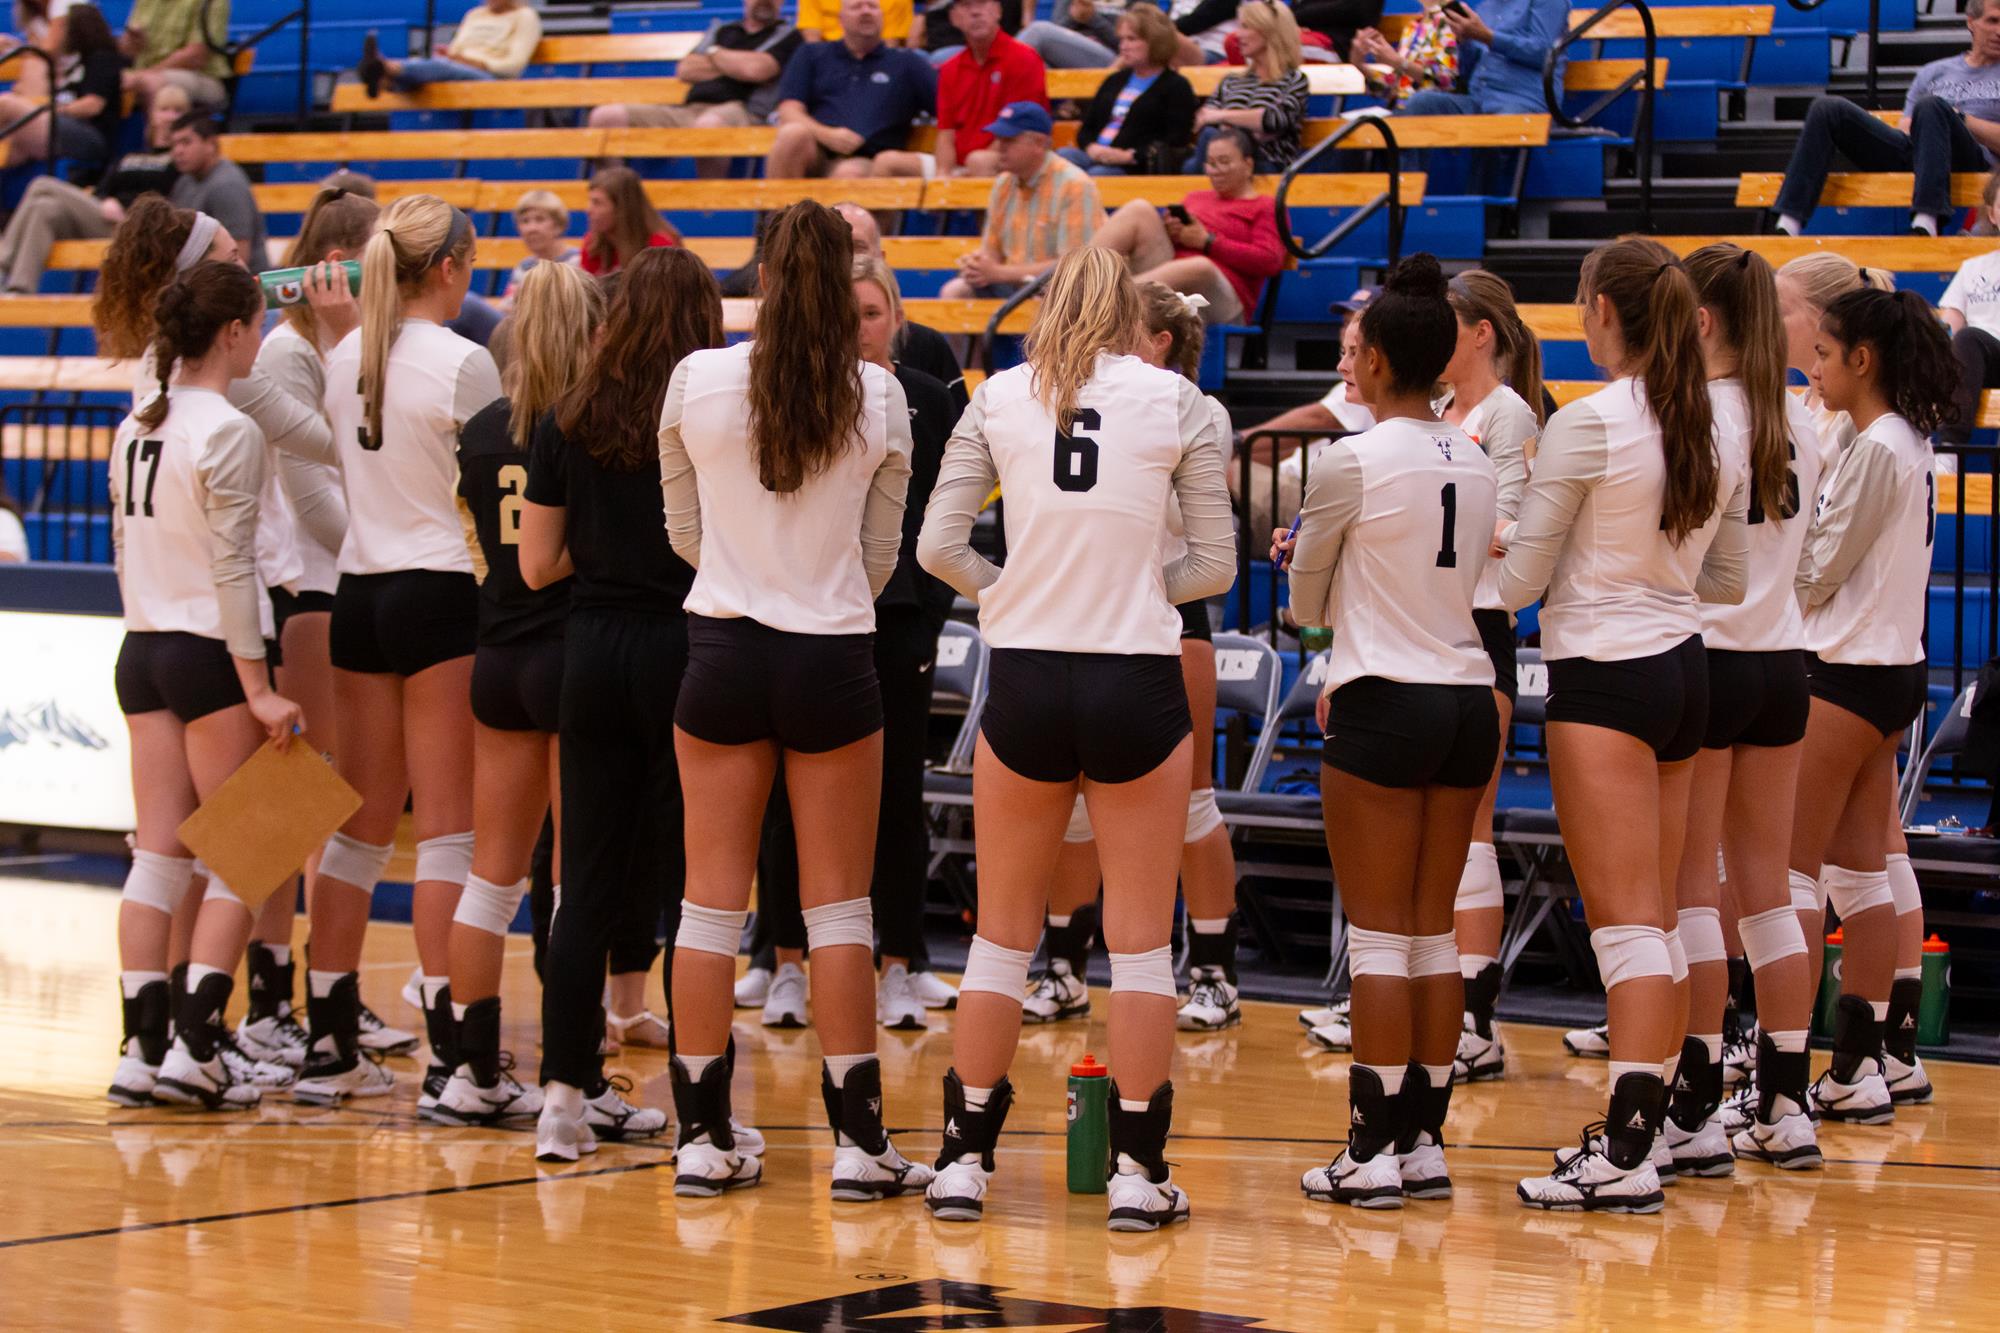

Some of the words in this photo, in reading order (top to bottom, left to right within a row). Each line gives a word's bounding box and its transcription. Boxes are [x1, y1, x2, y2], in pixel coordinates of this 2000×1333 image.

[125, 439, 164, 518] 17
[1053, 407, 1102, 492] 6
[1435, 482, 1457, 568] 1
